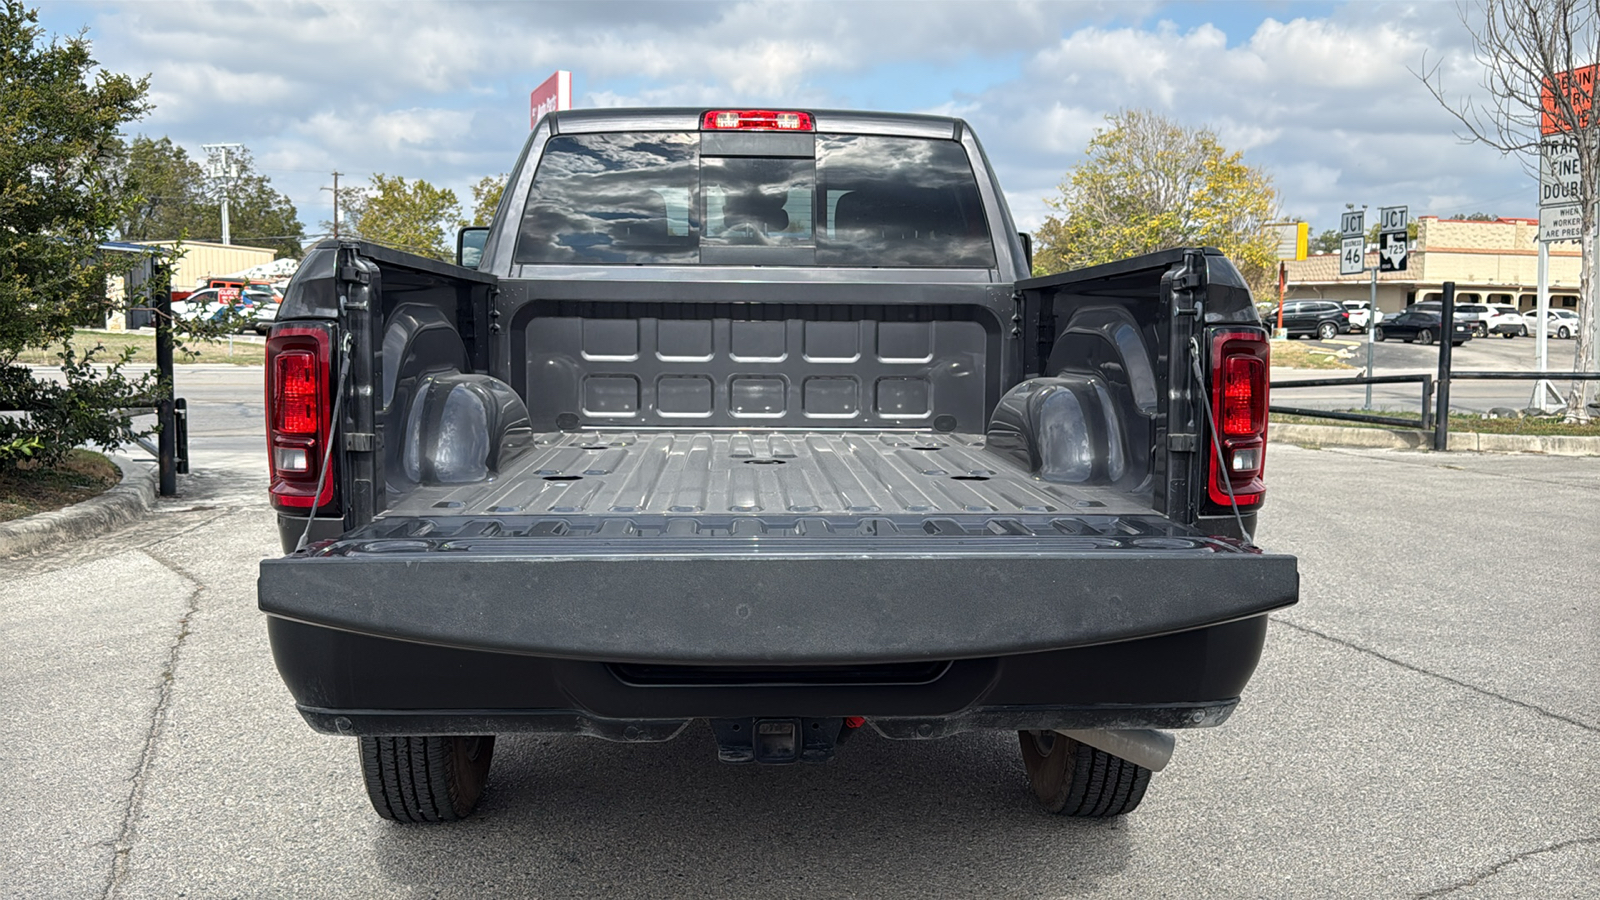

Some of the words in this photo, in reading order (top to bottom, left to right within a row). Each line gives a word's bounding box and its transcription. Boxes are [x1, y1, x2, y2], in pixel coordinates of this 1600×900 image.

[1551, 159, 1580, 177] FINE
[1544, 181, 1583, 200] DOUBL
[1382, 210, 1405, 228] JCT
[1560, 207, 1579, 216] WHEN
[1343, 215, 1362, 233] JCT
[1553, 217, 1582, 228] WORKER
[1546, 229, 1560, 238] ARE
[1561, 227, 1582, 237] PRES
[1344, 248, 1360, 265] 46
[1388, 244, 1404, 255] 725
